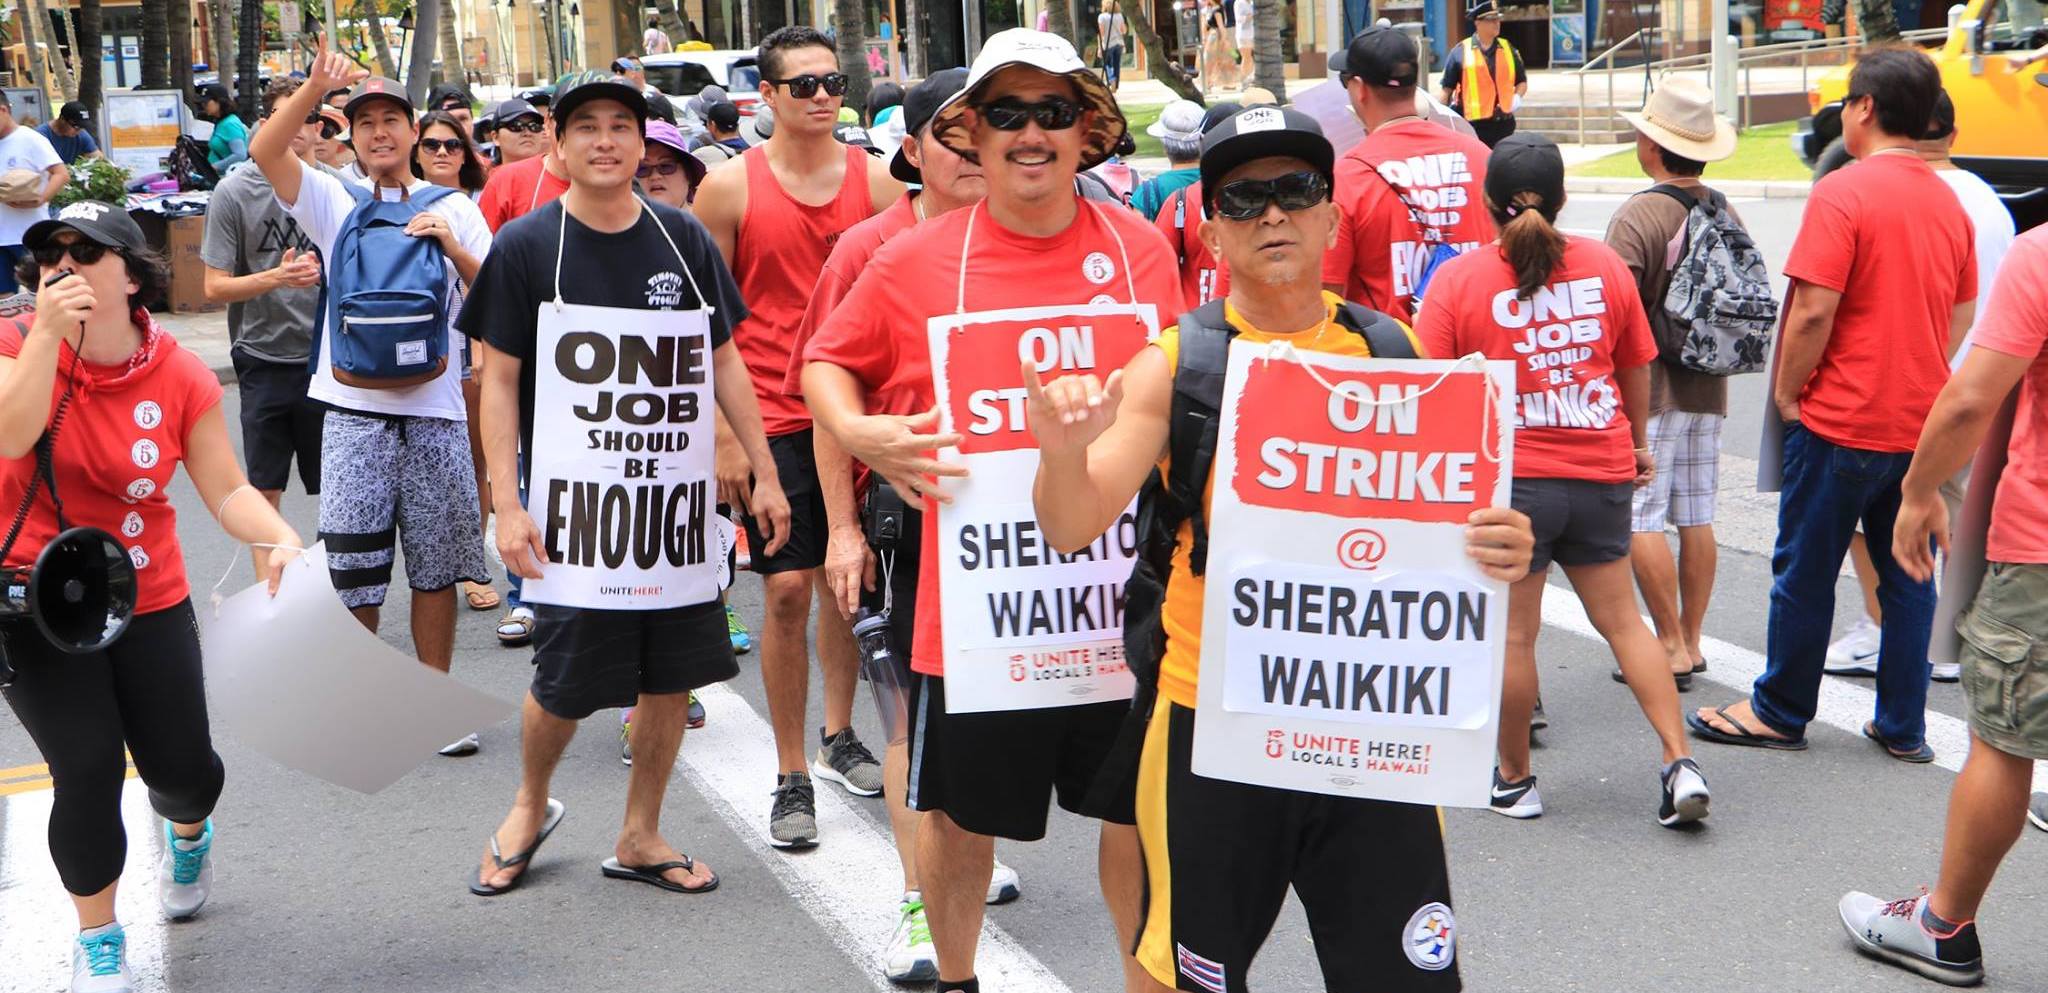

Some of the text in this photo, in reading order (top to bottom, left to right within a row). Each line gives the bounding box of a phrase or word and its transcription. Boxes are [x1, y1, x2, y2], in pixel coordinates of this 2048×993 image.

[1376, 152, 1472, 187] ONE
[1492, 276, 1606, 329] ONE
[1018, 325, 1096, 374] ON
[1512, 318, 1602, 354] JOB
[555, 331, 706, 387] ONE
[1527, 346, 1593, 371] SHOULD
[1548, 367, 1574, 386] BE
[573, 391, 699, 425] JOB
[1327, 379, 1419, 435] ON
[587, 429, 690, 453] SHOULD
[624, 458, 659, 479] BE
[1257, 436, 1477, 503] STRIKE
[545, 478, 706, 570] ENOUGH
[1337, 528, 1388, 571] @
[1232, 577, 1486, 641] SHERATON
[1032, 648, 1090, 668] UNITE
[1033, 667, 1081, 681] LOCAL
[1260, 654, 1451, 715] WAIKIKI
[1292, 750, 1430, 775] LOCAL 5 HAWAII
[1293, 732, 1432, 762] UNITE HERE!
